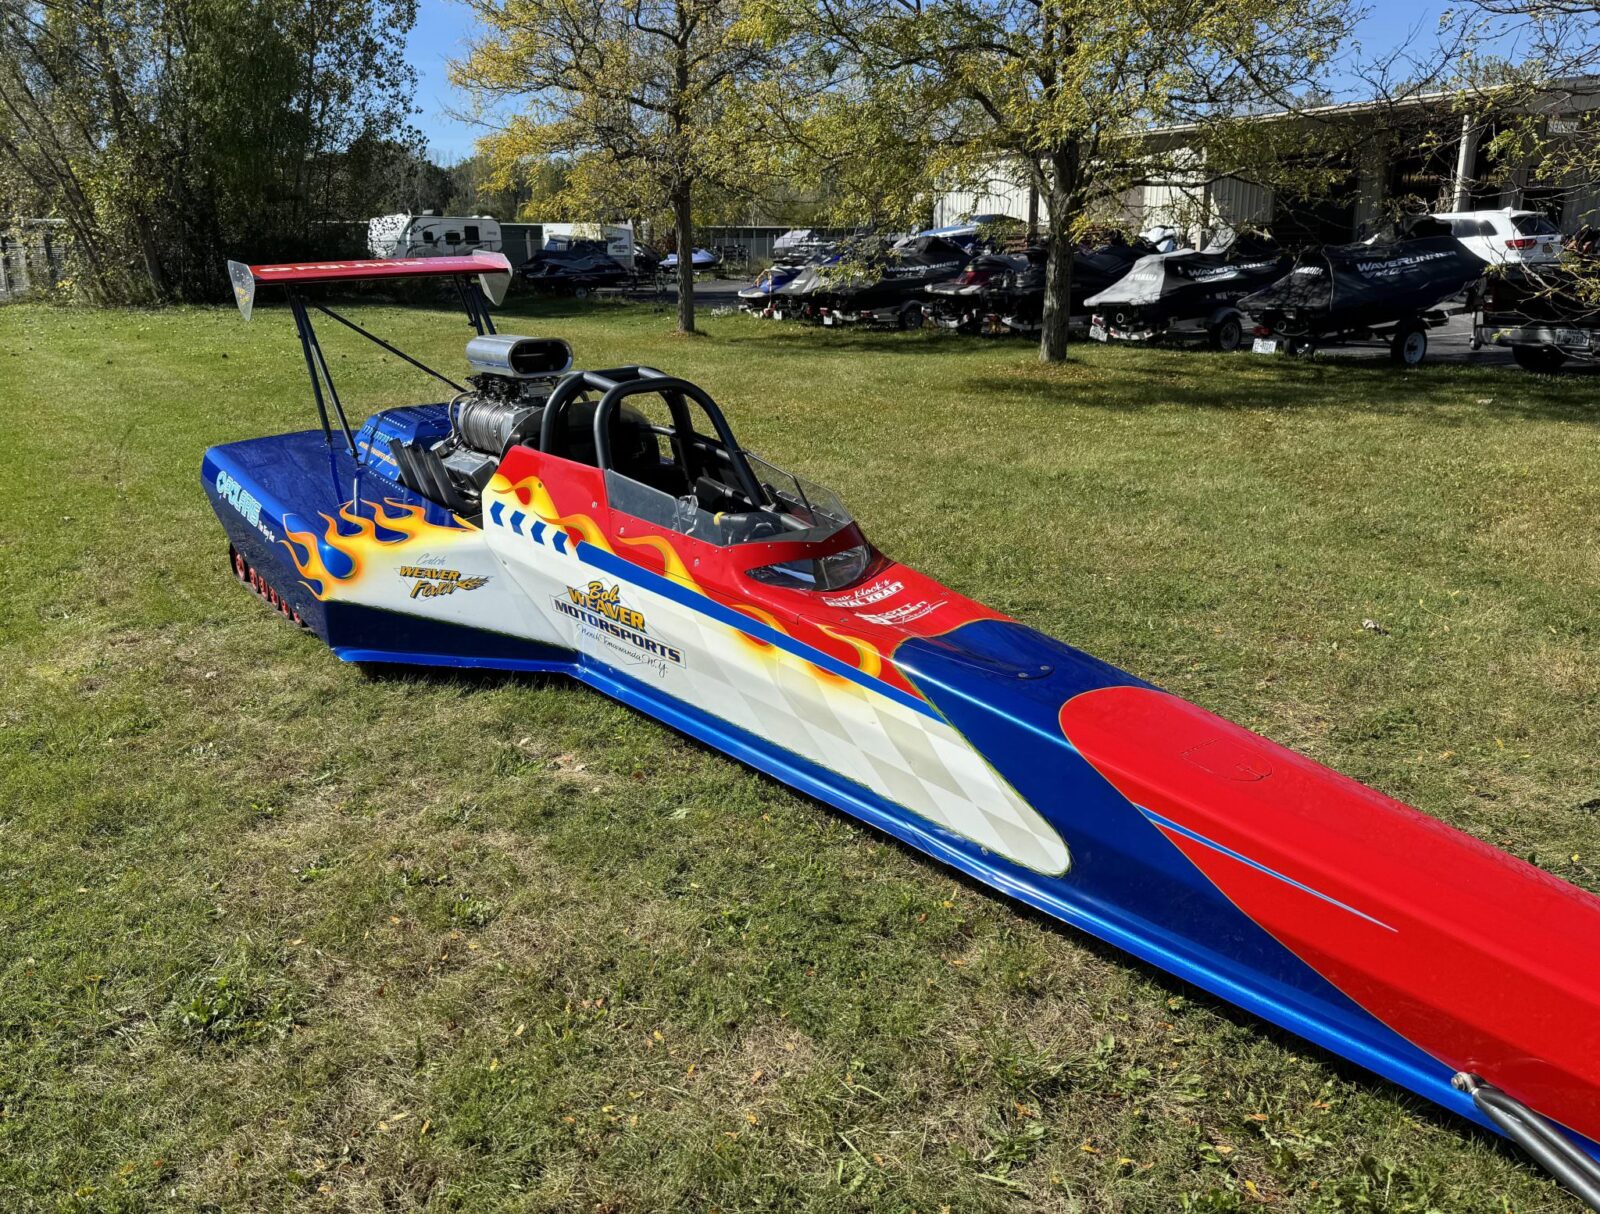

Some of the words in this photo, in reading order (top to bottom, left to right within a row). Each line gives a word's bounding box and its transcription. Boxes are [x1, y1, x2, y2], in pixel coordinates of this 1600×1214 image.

[400, 565, 461, 581] WEAVER
[587, 580, 621, 606] Bob
[865, 581, 905, 604] KRAFT
[566, 584, 649, 634] WEAVER
[554, 599, 681, 664] MOTORSPORTS
